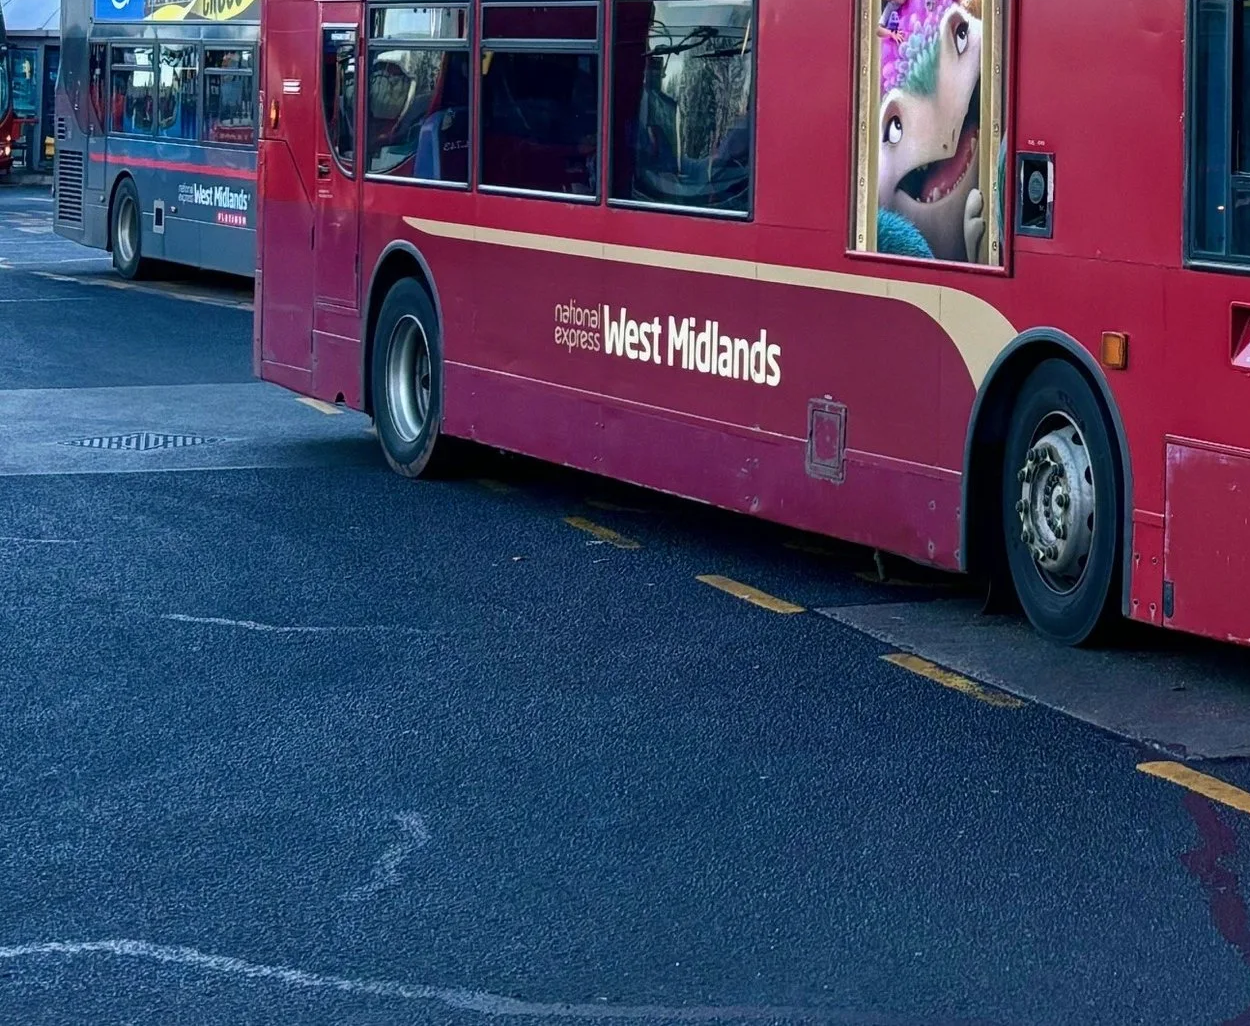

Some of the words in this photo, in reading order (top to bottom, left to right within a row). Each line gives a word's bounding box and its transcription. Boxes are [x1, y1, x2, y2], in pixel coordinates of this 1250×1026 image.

[193, 183, 213, 206] West
[213, 186, 248, 211] Midlands
[554, 298, 601, 330] national
[554, 325, 601, 354] express
[603, 304, 662, 365] West
[667, 315, 782, 387] Midlands
